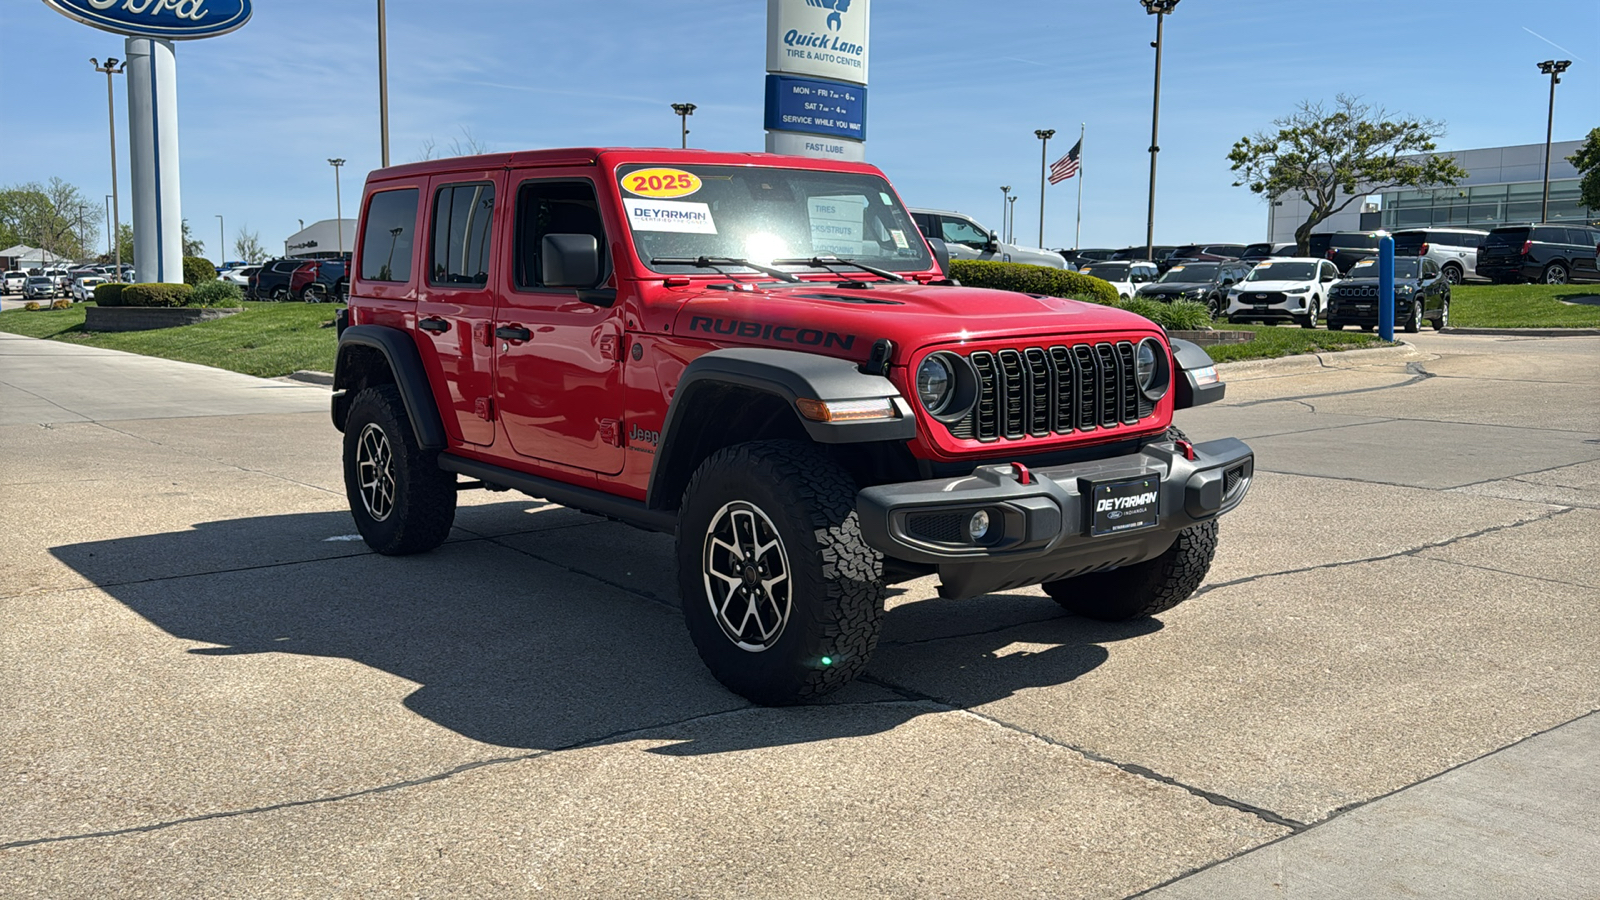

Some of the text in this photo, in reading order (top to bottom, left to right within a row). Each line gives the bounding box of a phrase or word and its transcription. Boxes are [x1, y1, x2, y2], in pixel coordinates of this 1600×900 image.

[784, 29, 863, 56] Quick Lane
[786, 49, 862, 69] TIRE & AUTO CENTER
[793, 86, 810, 95] MON
[817, 88, 828, 97] FRI
[804, 102, 817, 111] SAT
[782, 114, 861, 131] SERVICE WHILE YOU WAIT
[805, 142, 844, 154] FAST LUBE
[632, 173, 692, 192] 2025
[634, 207, 706, 221] DEYARMAN
[815, 205, 836, 214] TIRES
[811, 224, 852, 235] CKS/STRUTS
[689, 315, 856, 350] RUBICON
[629, 423, 659, 447] Jeep
[1096, 491, 1158, 512] DEYARMAN
